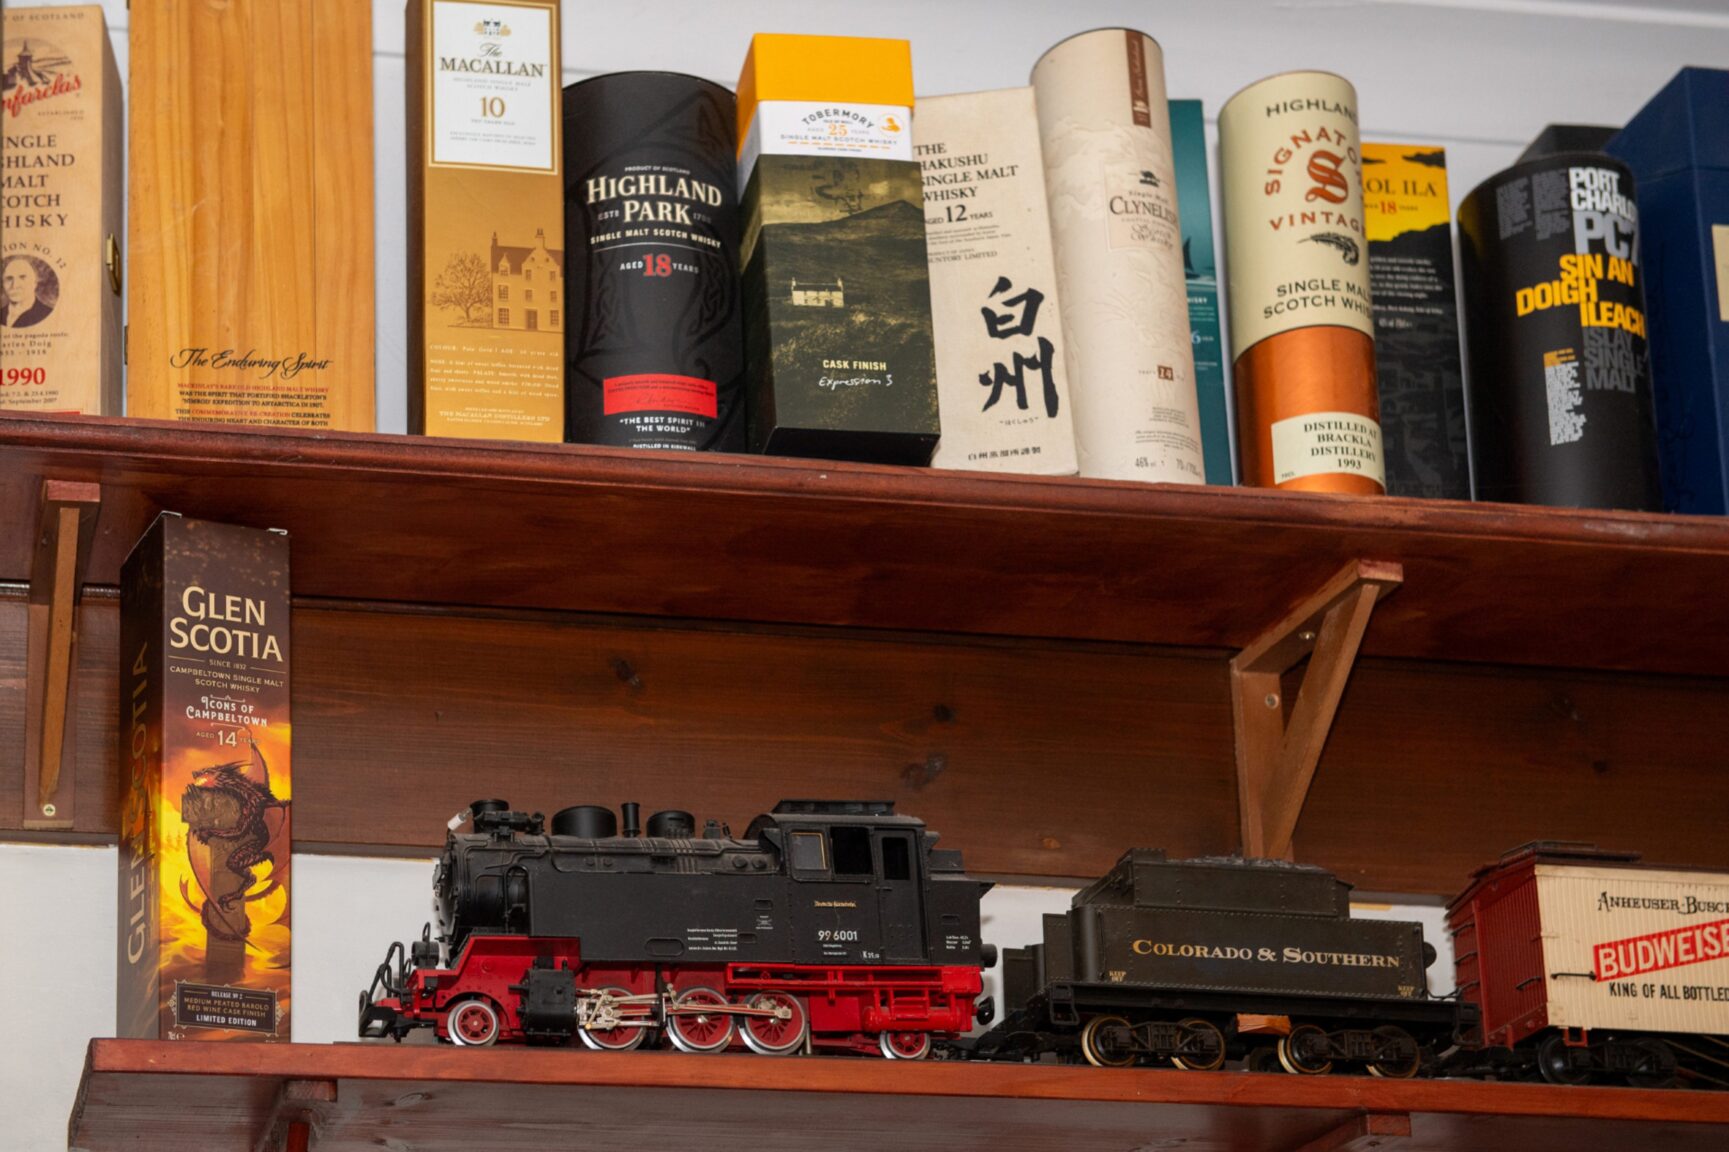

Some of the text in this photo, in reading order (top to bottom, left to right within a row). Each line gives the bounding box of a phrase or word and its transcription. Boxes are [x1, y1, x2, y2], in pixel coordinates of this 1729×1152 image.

[479, 43, 503, 58] The
[440, 57, 545, 78] MACALLAN
[480, 96, 506, 118] 10
[801, 108, 875, 129] TOBERMORY
[811, 134, 831, 142] MALT
[833, 135, 866, 144] SCOTCH
[827, 123, 848, 136] 25
[914, 143, 947, 156] THE
[1, 154, 76, 169] HLAND
[662, 166, 691, 175] SCOTLAND
[976, 164, 1019, 181] MALT
[1568, 166, 1621, 191] PORT
[586, 174, 723, 207] HIGHLAND
[1402, 179, 1438, 199] ILA
[623, 200, 693, 226] PARK
[945, 203, 994, 223] 12 YEARS
[1379, 200, 1398, 215] 18
[590, 228, 722, 249] SINGLE MALT SCOTCH WHISKY
[619, 253, 700, 278] AGED 18 YEARS
[964, 250, 999, 261] LIMITED
[1559, 252, 1635, 287] SIN AN
[1276, 278, 1342, 299] SINGLE
[1515, 277, 1599, 318] DOIGH
[1263, 294, 1336, 319] SCOTCH
[1579, 301, 1647, 340] ILEACH
[978, 275, 1060, 419] 白州
[1582, 325, 1634, 350] ISLAY
[170, 348, 334, 380] The Enduring Spirit
[823, 359, 888, 371] CASK FINISH
[1583, 346, 1648, 378] SINGLE
[0, 367, 47, 387] 1990
[818, 374, 894, 391] Expression 3
[1585, 366, 1638, 394] MALT
[635, 425, 654, 433] THE
[643, 416, 665, 424] BEST
[667, 416, 694, 427] SPIRIT
[1304, 420, 1378, 440] DISTILLED AT
[1317, 433, 1373, 449] BRACKLA
[1310, 446, 1377, 463] DISTILLERY
[1337, 458, 1363, 470] 1993
[182, 586, 267, 627] GLEN
[169, 616, 284, 663] SCOTIA
[209, 658, 248, 671] SINCE 1832
[169, 665, 285, 688] CAMPBELTOWN SINGLE MALT
[194, 678, 261, 694] SCOTCH WHISKY
[200, 695, 255, 714] ICONS OF
[186, 705, 268, 728] CAMPBELTOWN
[196, 731, 216, 739] AGED
[217, 730, 238, 748] 14
[127, 641, 148, 966] GLEN SCOTIA
[818, 930, 858, 942] 99 6001
[1132, 939, 1401, 969] COLORADO & SOUTHERN
[211, 990, 231, 999] RELEASE
[1609, 982, 1638, 998] KING
[1642, 983, 1656, 999] OF
[1659, 984, 1681, 1000] ALL
[184, 997, 270, 1011] MEDIUM PEATED BAROLO
[187, 1004, 266, 1018] RED WINE CASK FINISH
[196, 1014, 257, 1027] LIMITED EDITION
